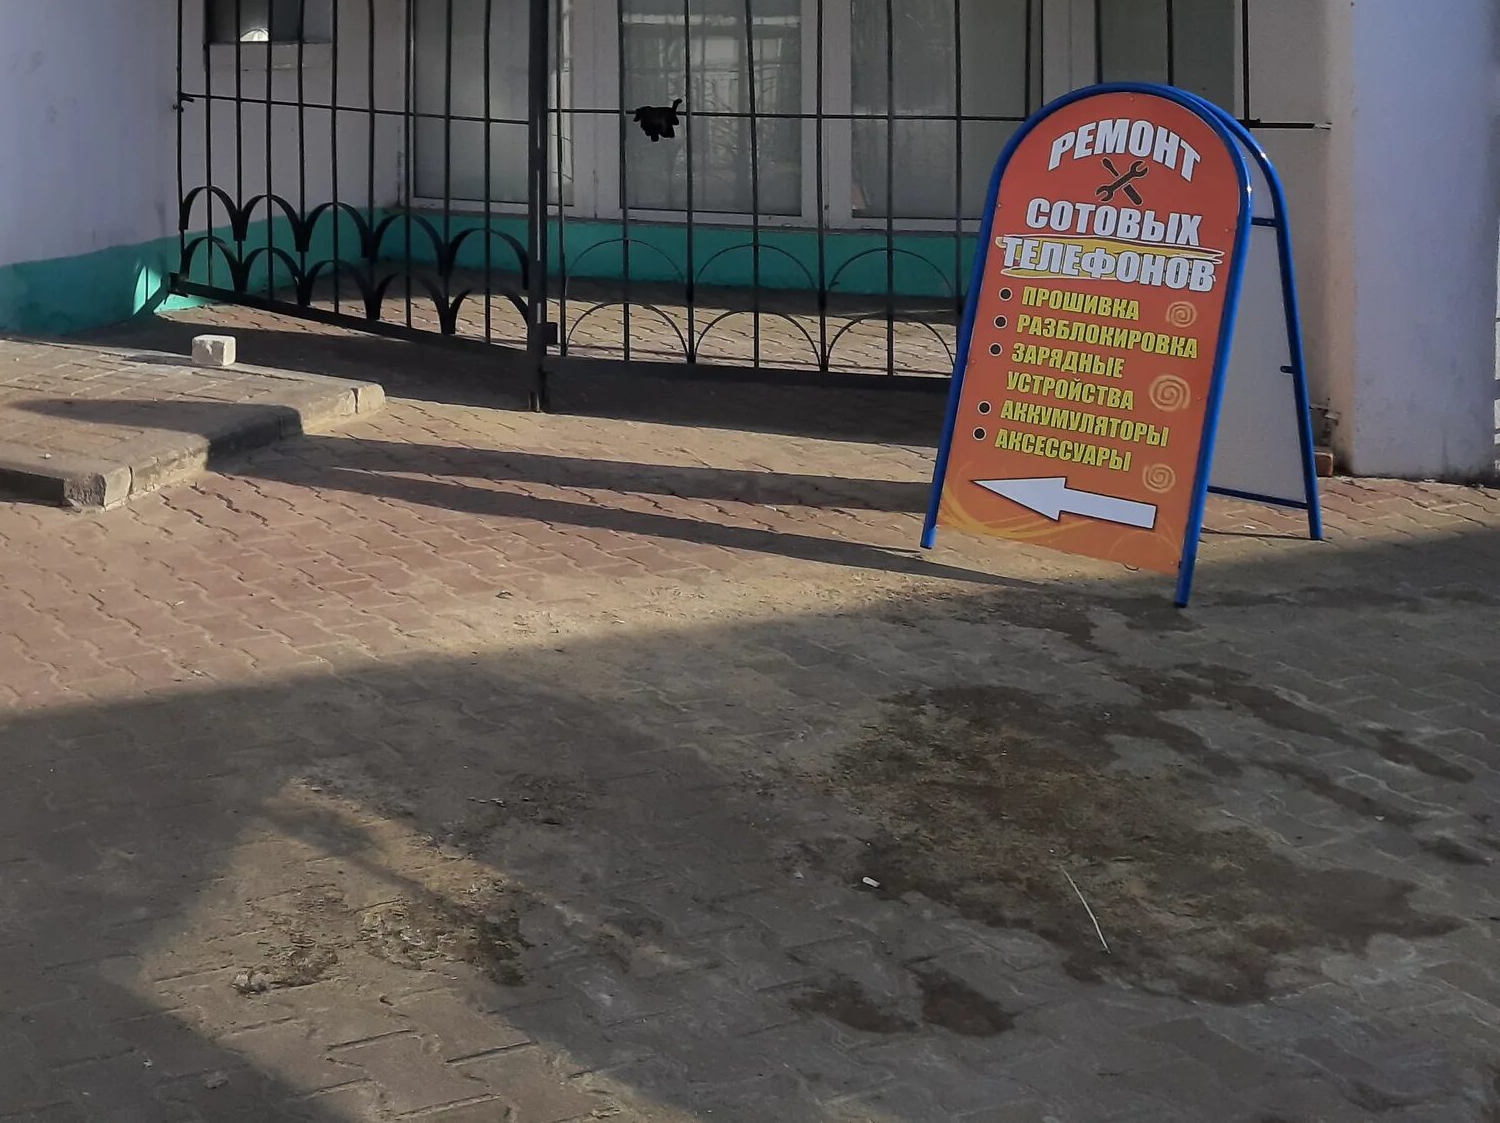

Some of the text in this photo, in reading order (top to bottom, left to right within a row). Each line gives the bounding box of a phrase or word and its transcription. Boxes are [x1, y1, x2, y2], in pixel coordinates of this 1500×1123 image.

[1047, 118, 1201, 182] РЕМОНТ
[1025, 197, 1202, 246] СОТОВЫХ
[1001, 236, 1215, 292] ТЕЛЕФОНОВ
[1021, 285, 1140, 321] ПРОШИВКА
[1016, 314, 1199, 359] РАЗБЛОКИРОВКА
[1012, 342, 1125, 379] ЗАРЯДНЫЕ
[1006, 371, 1134, 411] УСТРОЙСТВА
[1000, 399, 1169, 447] АККУМУЛЯТОРЫ
[994, 428, 1131, 473] АКСЕССУАРЫ
